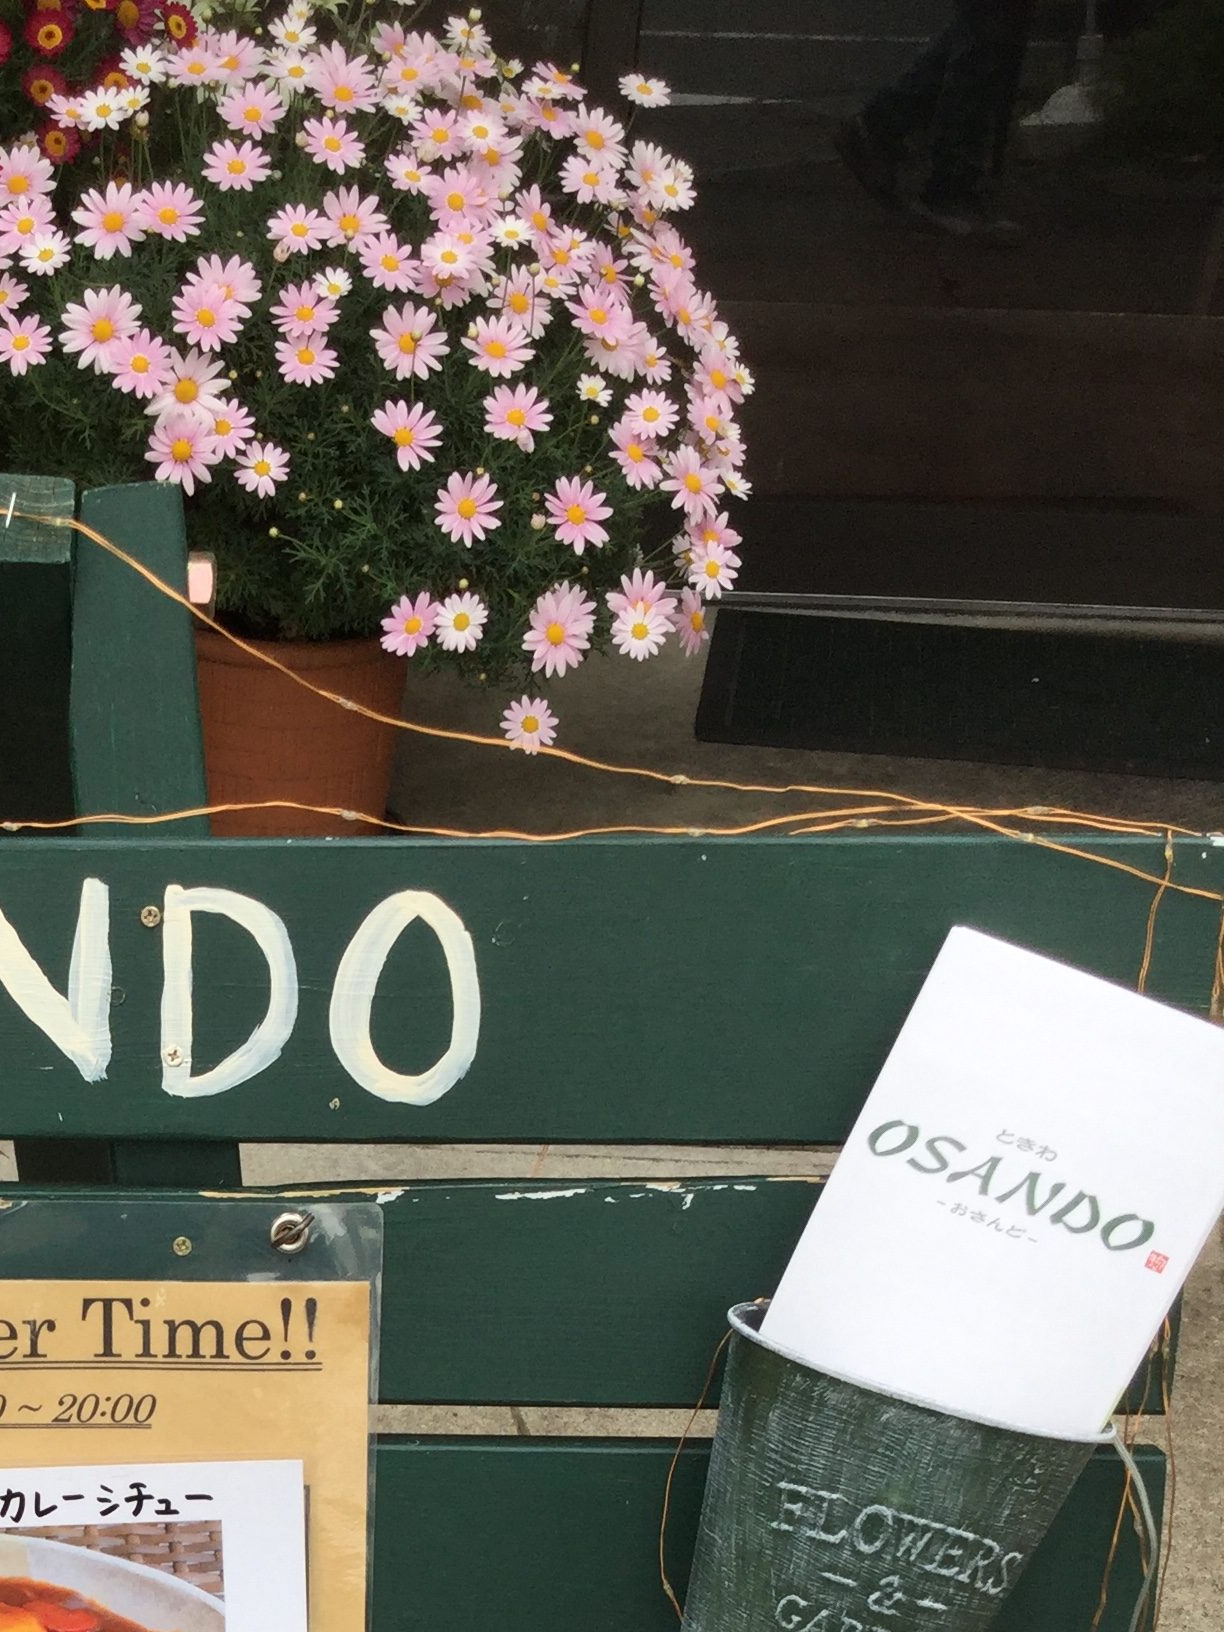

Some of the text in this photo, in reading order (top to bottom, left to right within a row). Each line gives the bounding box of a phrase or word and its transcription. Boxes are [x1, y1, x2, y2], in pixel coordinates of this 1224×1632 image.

[867, 1119, 1156, 1252] OSANDO
[995, 1128, 1058, 1162] ときわ
[80, 1296, 319, 1361] Time!!
[770, 1480, 1024, 1595] FLOWERS
